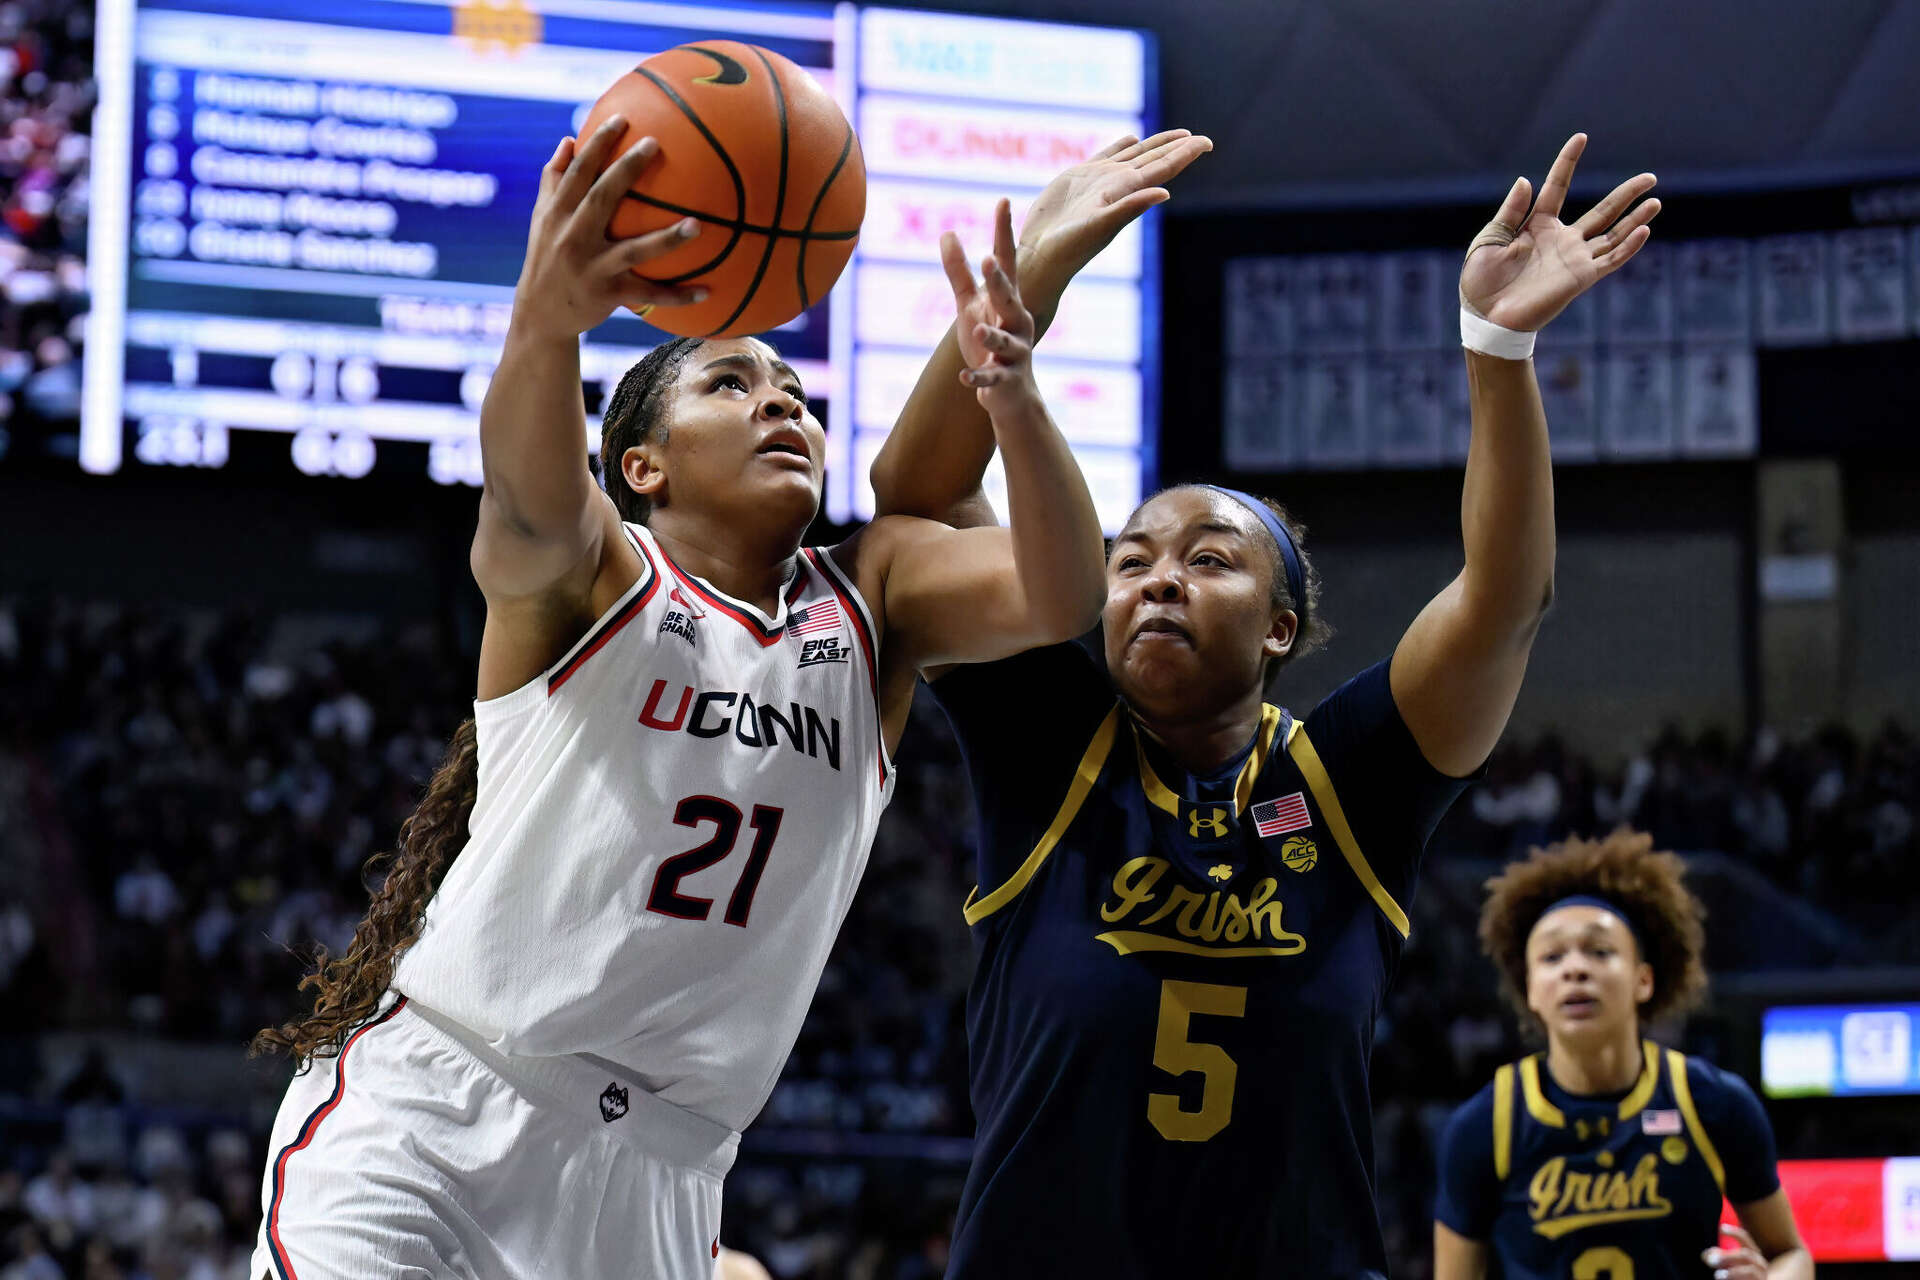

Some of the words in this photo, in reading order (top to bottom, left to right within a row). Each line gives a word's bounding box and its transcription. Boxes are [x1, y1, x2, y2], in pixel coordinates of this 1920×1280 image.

[665, 611, 684, 624] BE
[800, 648, 850, 662] EAST
[803, 637, 838, 652] BIG
[638, 679, 841, 771] UCONN
[646, 794, 784, 928] 21
[1286, 844, 1317, 859] ACC
[1097, 856, 1306, 954] Irish
[1147, 979, 1248, 1142] 5
[1528, 1154, 1673, 1232] Irish
